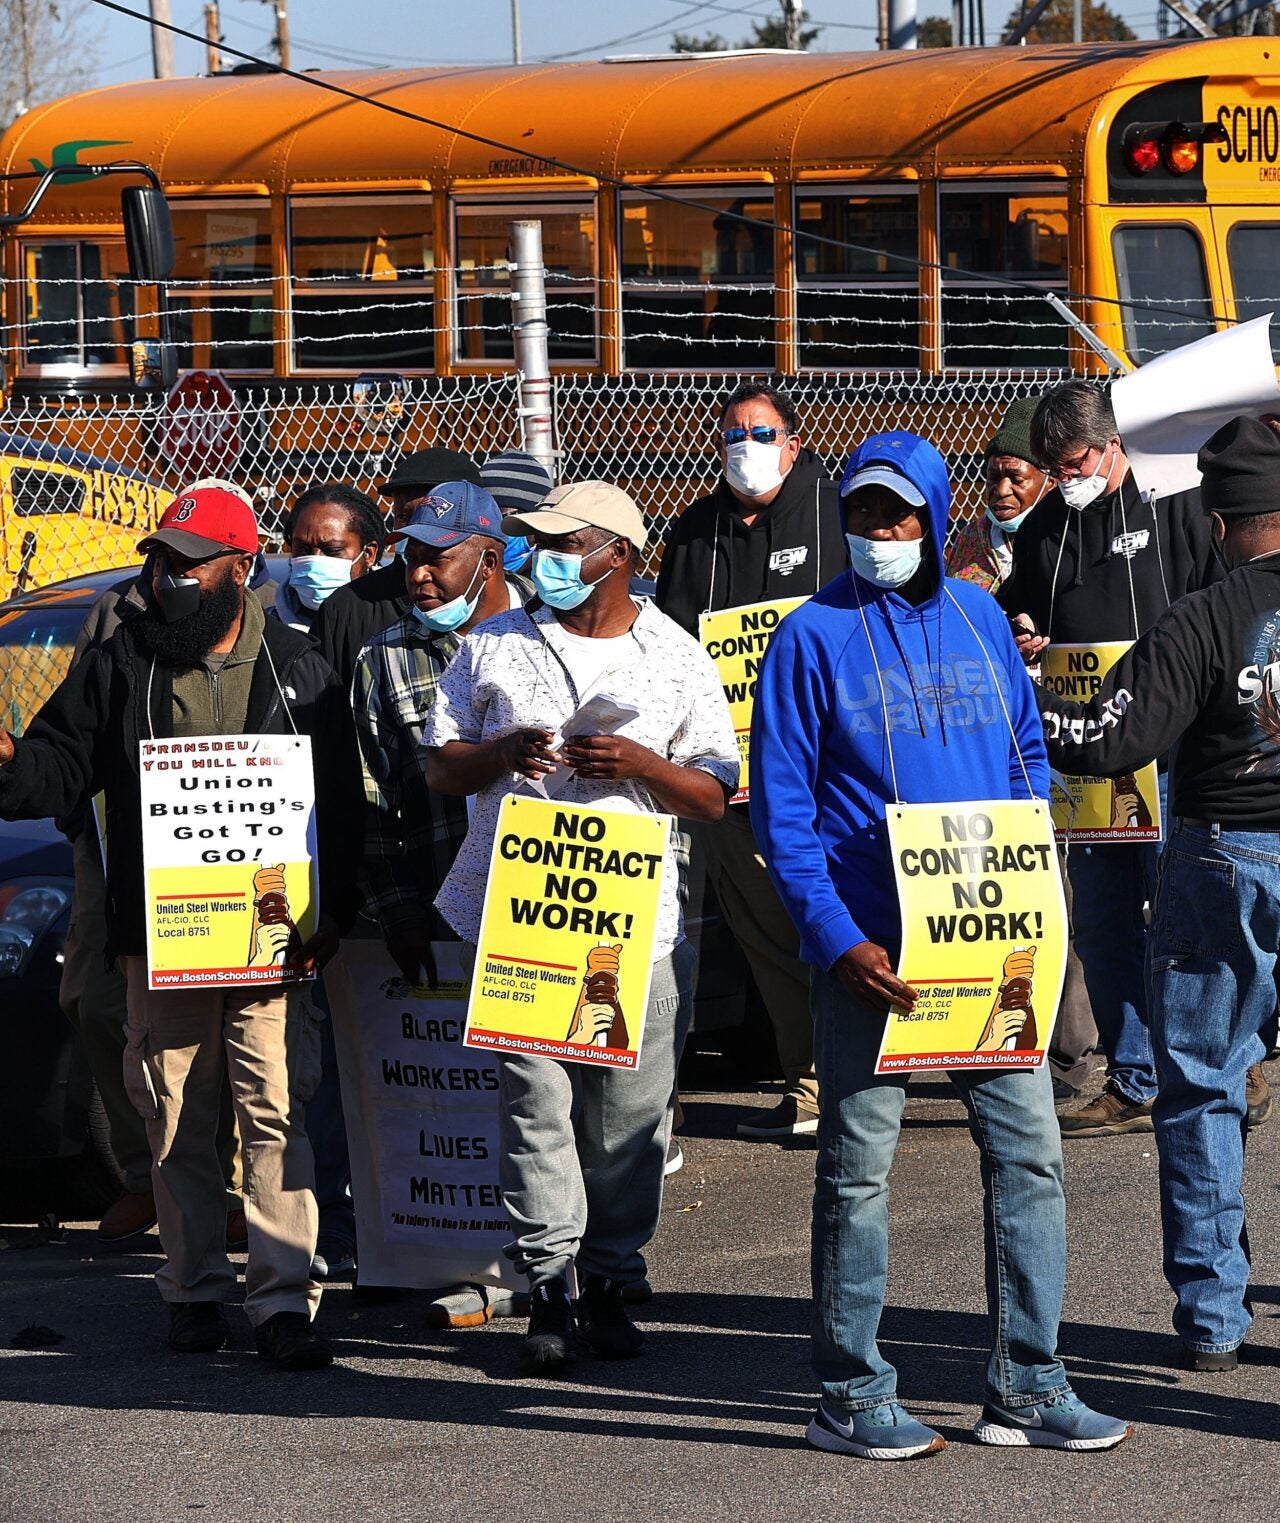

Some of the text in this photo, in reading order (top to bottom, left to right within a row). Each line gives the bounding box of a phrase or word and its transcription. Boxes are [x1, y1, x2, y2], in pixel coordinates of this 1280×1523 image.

[489, 158, 535, 174] EMERGENCY
[172, 498, 196, 522] B
[769, 546, 808, 570] USW
[741, 609, 780, 632] NO
[707, 633, 771, 660] CONT
[1257, 622, 1276, 650] YEARS
[1068, 652, 1099, 672] NO
[1044, 675, 1102, 696] CONTR
[850, 696, 1000, 737] ARMOU
[143, 756, 285, 772] YOU WILL KNO
[179, 775, 273, 791] Union
[150, 798, 305, 817] Busting's
[173, 823, 283, 840] Got To
[553, 811, 606, 843] NO
[941, 813, 993, 842] NO
[201, 848, 263, 863] GO!
[500, 833, 662, 880] CONTRACT
[900, 844, 1051, 876] CONTRACT
[544, 873, 598, 904] NO
[952, 880, 1003, 909] NO
[156, 901, 247, 915] United Steel Workers
[193, 915, 210, 923] CLC
[510, 897, 634, 939] WORK!
[157, 927, 210, 938] Local 8751
[927, 912, 1043, 943] WORK!
[483, 976, 537, 990] AFL-CIO, CLC
[485, 962, 576, 986] United Steel Workers
[482, 987, 536, 1004] Local 8751
[932, 988, 954, 998] Steel
[956, 987, 991, 997] Workers
[936, 1000, 952, 1008] CLC
[401, 1012, 464, 1043] BLAC
[897, 1011, 949, 1022] Local 8751
[471, 1033, 634, 1066] www.BostonSchoolBusUnion.org
[883, 1055, 1040, 1069] www.BostonSchoolBusUnion.org
[382, 1059, 500, 1091] WORKERS
[406, 1214, 430, 1227] Injury
[431, 1216, 440, 1228] To
[441, 1217, 458, 1230] One
[468, 1219, 481, 1231] An
